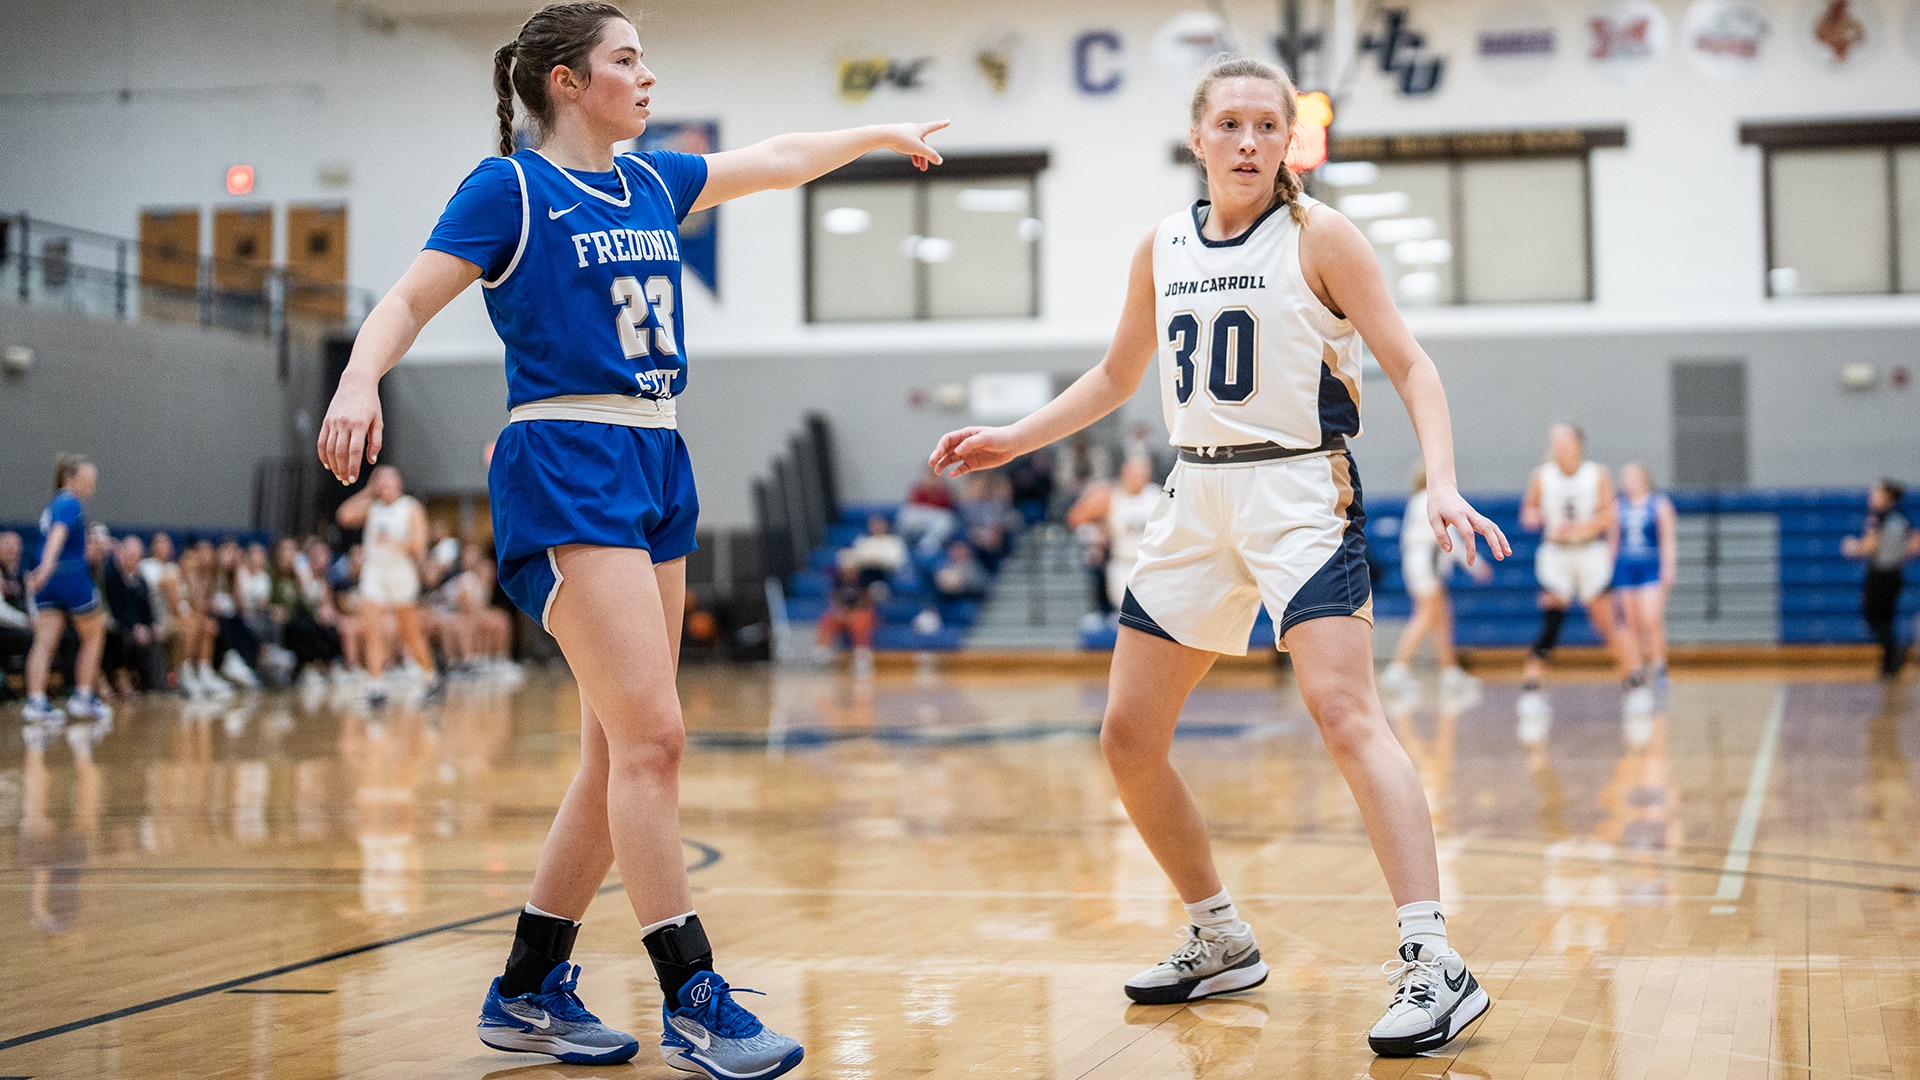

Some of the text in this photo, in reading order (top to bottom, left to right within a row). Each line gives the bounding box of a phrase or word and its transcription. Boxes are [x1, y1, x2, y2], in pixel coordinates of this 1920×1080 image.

[1074, 31, 1120, 94] C
[572, 229, 680, 268] FREDONIA
[610, 275, 679, 360] 23
[1164, 275, 1266, 297] JOHN CARROLL
[1166, 305, 1260, 409] 30
